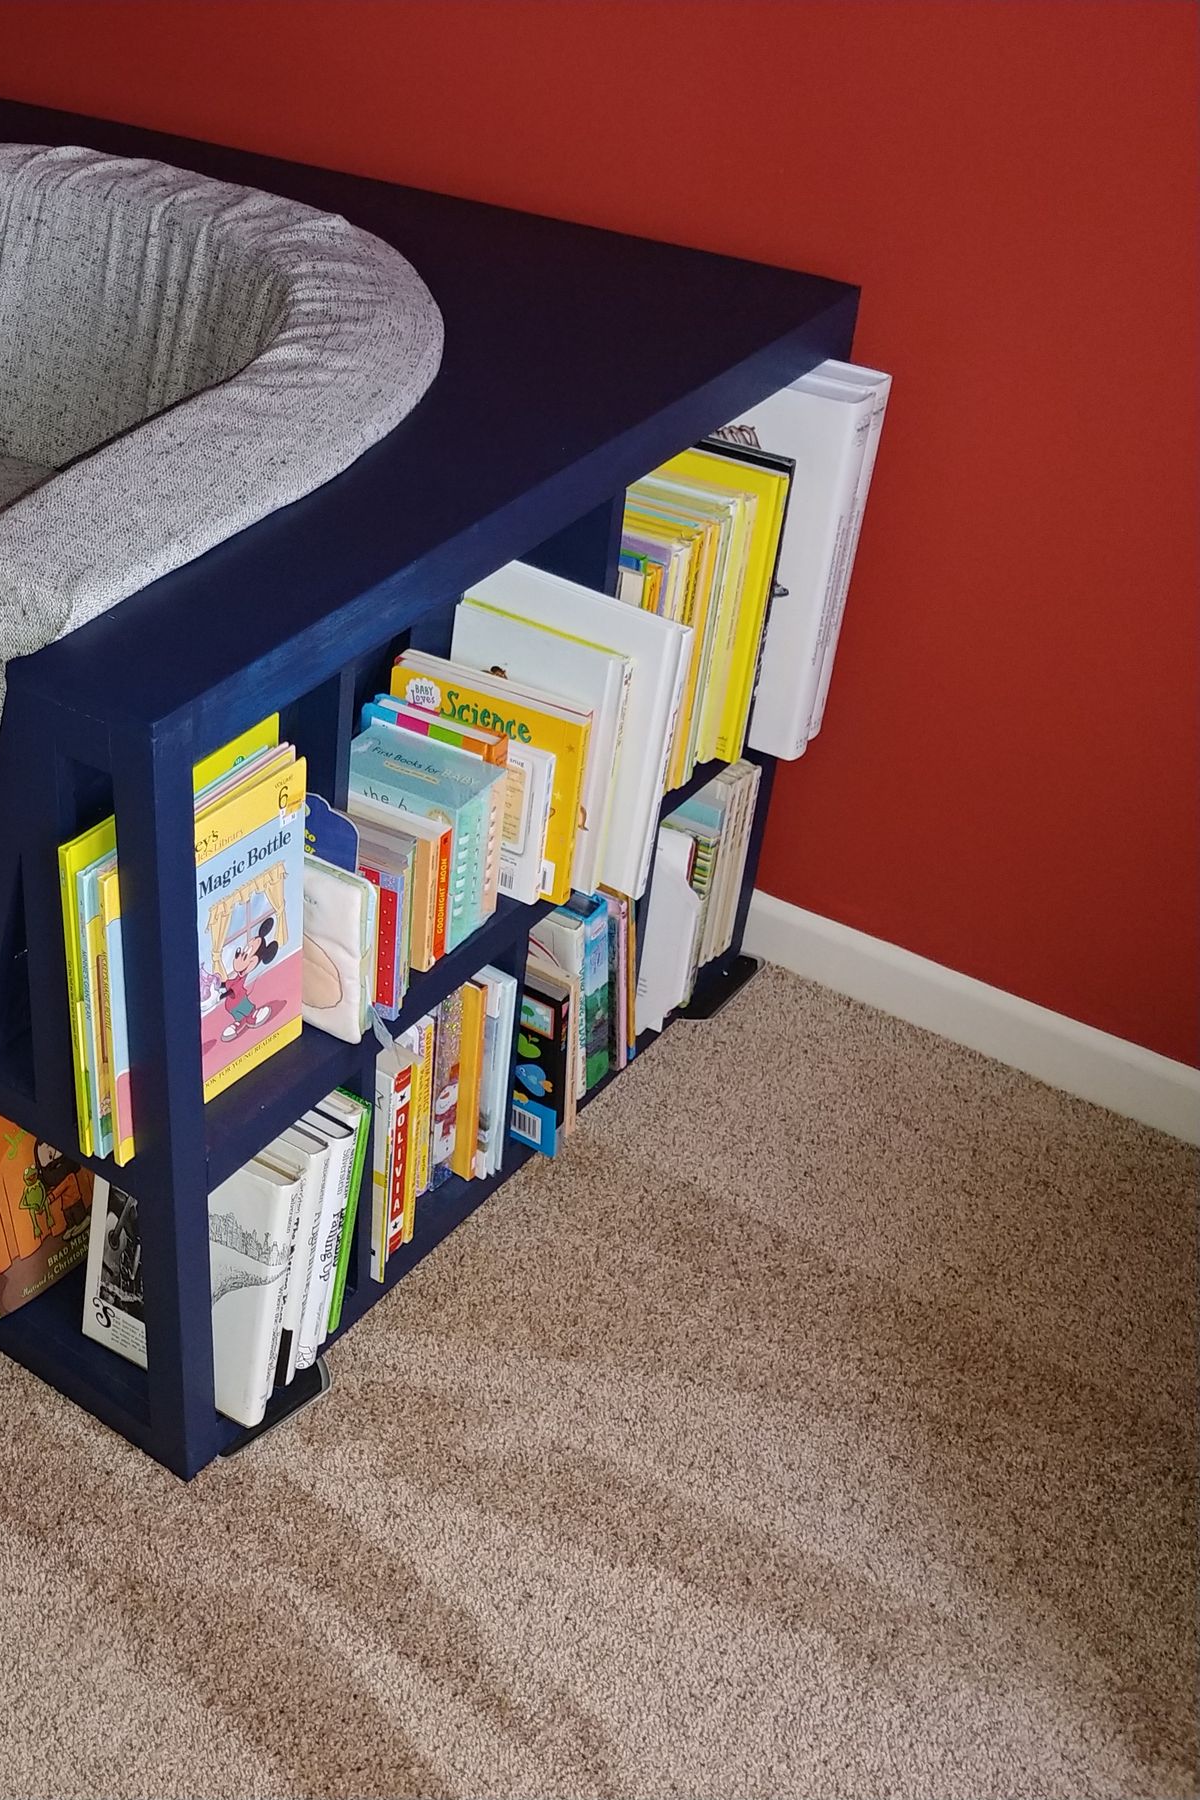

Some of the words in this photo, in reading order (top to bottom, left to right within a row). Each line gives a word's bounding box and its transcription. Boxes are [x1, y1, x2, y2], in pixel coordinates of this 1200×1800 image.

[410, 689, 436, 705] Loves
[414, 683, 435, 696] BABY
[440, 690, 532, 744] Science
[372, 745, 393, 759] First
[393, 752, 422, 769] Books
[422, 763, 441, 776] for
[278, 785, 289, 810] 6
[198, 860, 245, 900] Magic
[246, 830, 292, 868] Bottle
[440, 858, 448, 884] MOON
[437, 887, 446, 934] GOODNIGHT
[231, 1050, 255, 1069] YOUNG
[253, 1031, 281, 1053] READERS
[424, 1031, 433, 1075] QUANTUM
[422, 1074, 431, 1114] PHYSICS
[337, 1148, 351, 1196] Silverstein
[393, 1112, 406, 1213] OLIVIA
[286, 1192, 299, 1234] Silverstein
[320, 1210, 341, 1262] Falling
[47, 1246, 69, 1268] BRAD
[320, 1262, 333, 1282] Up
